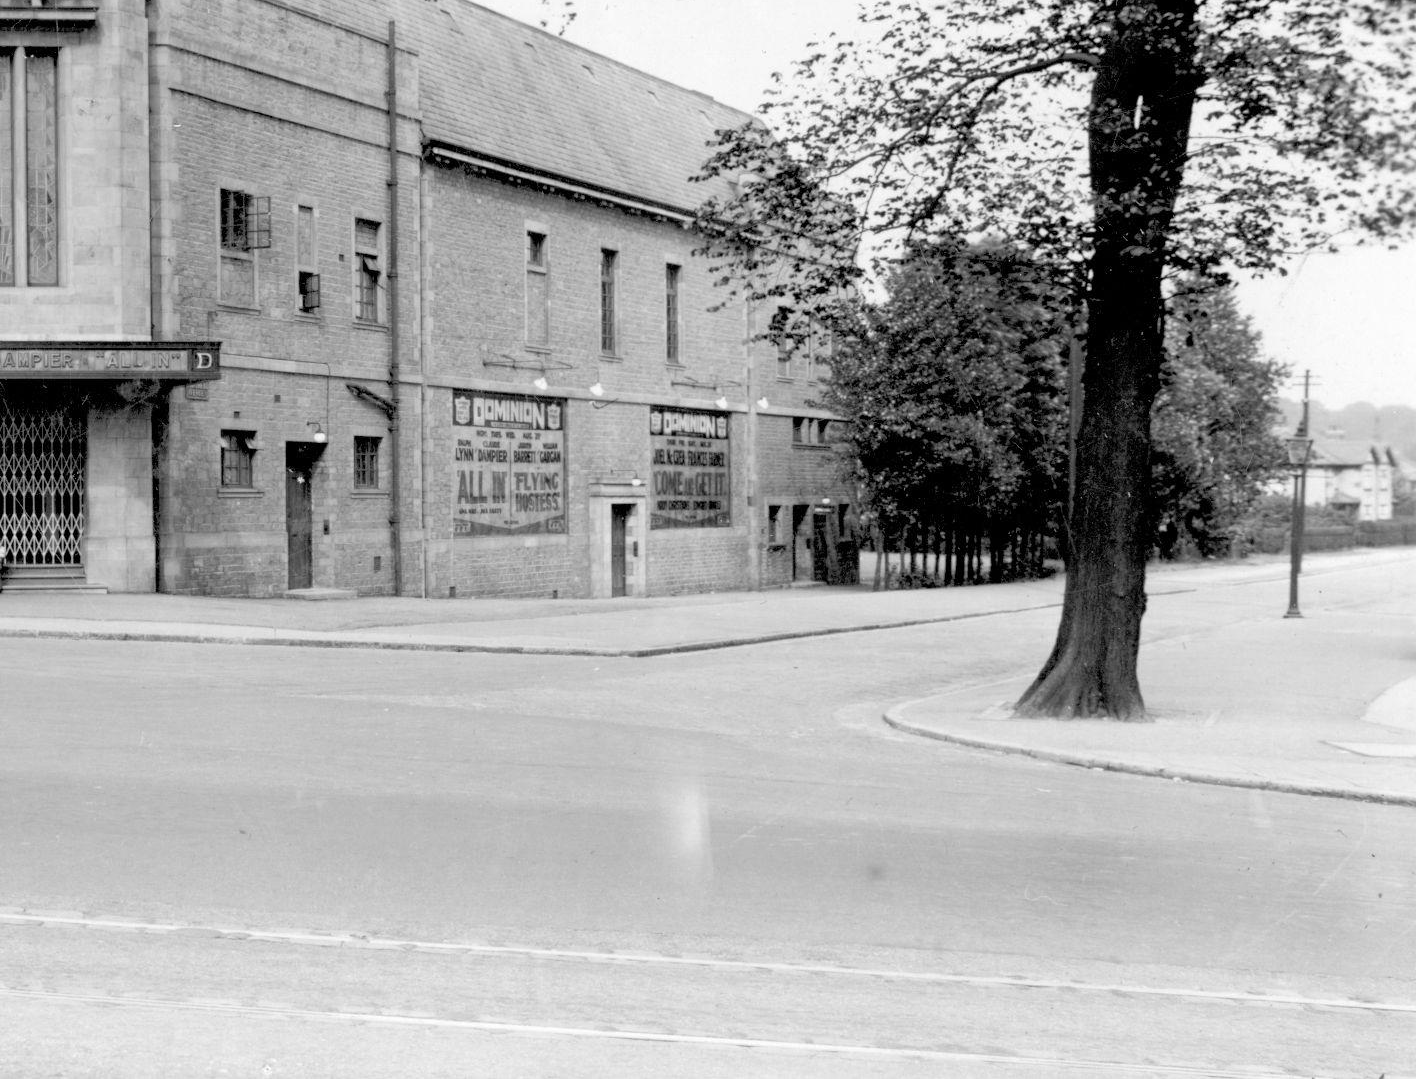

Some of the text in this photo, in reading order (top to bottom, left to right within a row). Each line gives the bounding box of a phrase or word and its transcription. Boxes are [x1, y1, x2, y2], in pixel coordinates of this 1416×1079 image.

[197, 352, 212, 369] D
[473, 397, 545, 430] DOMINION
[664, 411, 716, 439] DOMINION
[455, 448, 507, 463] LYNN DAMPIER
